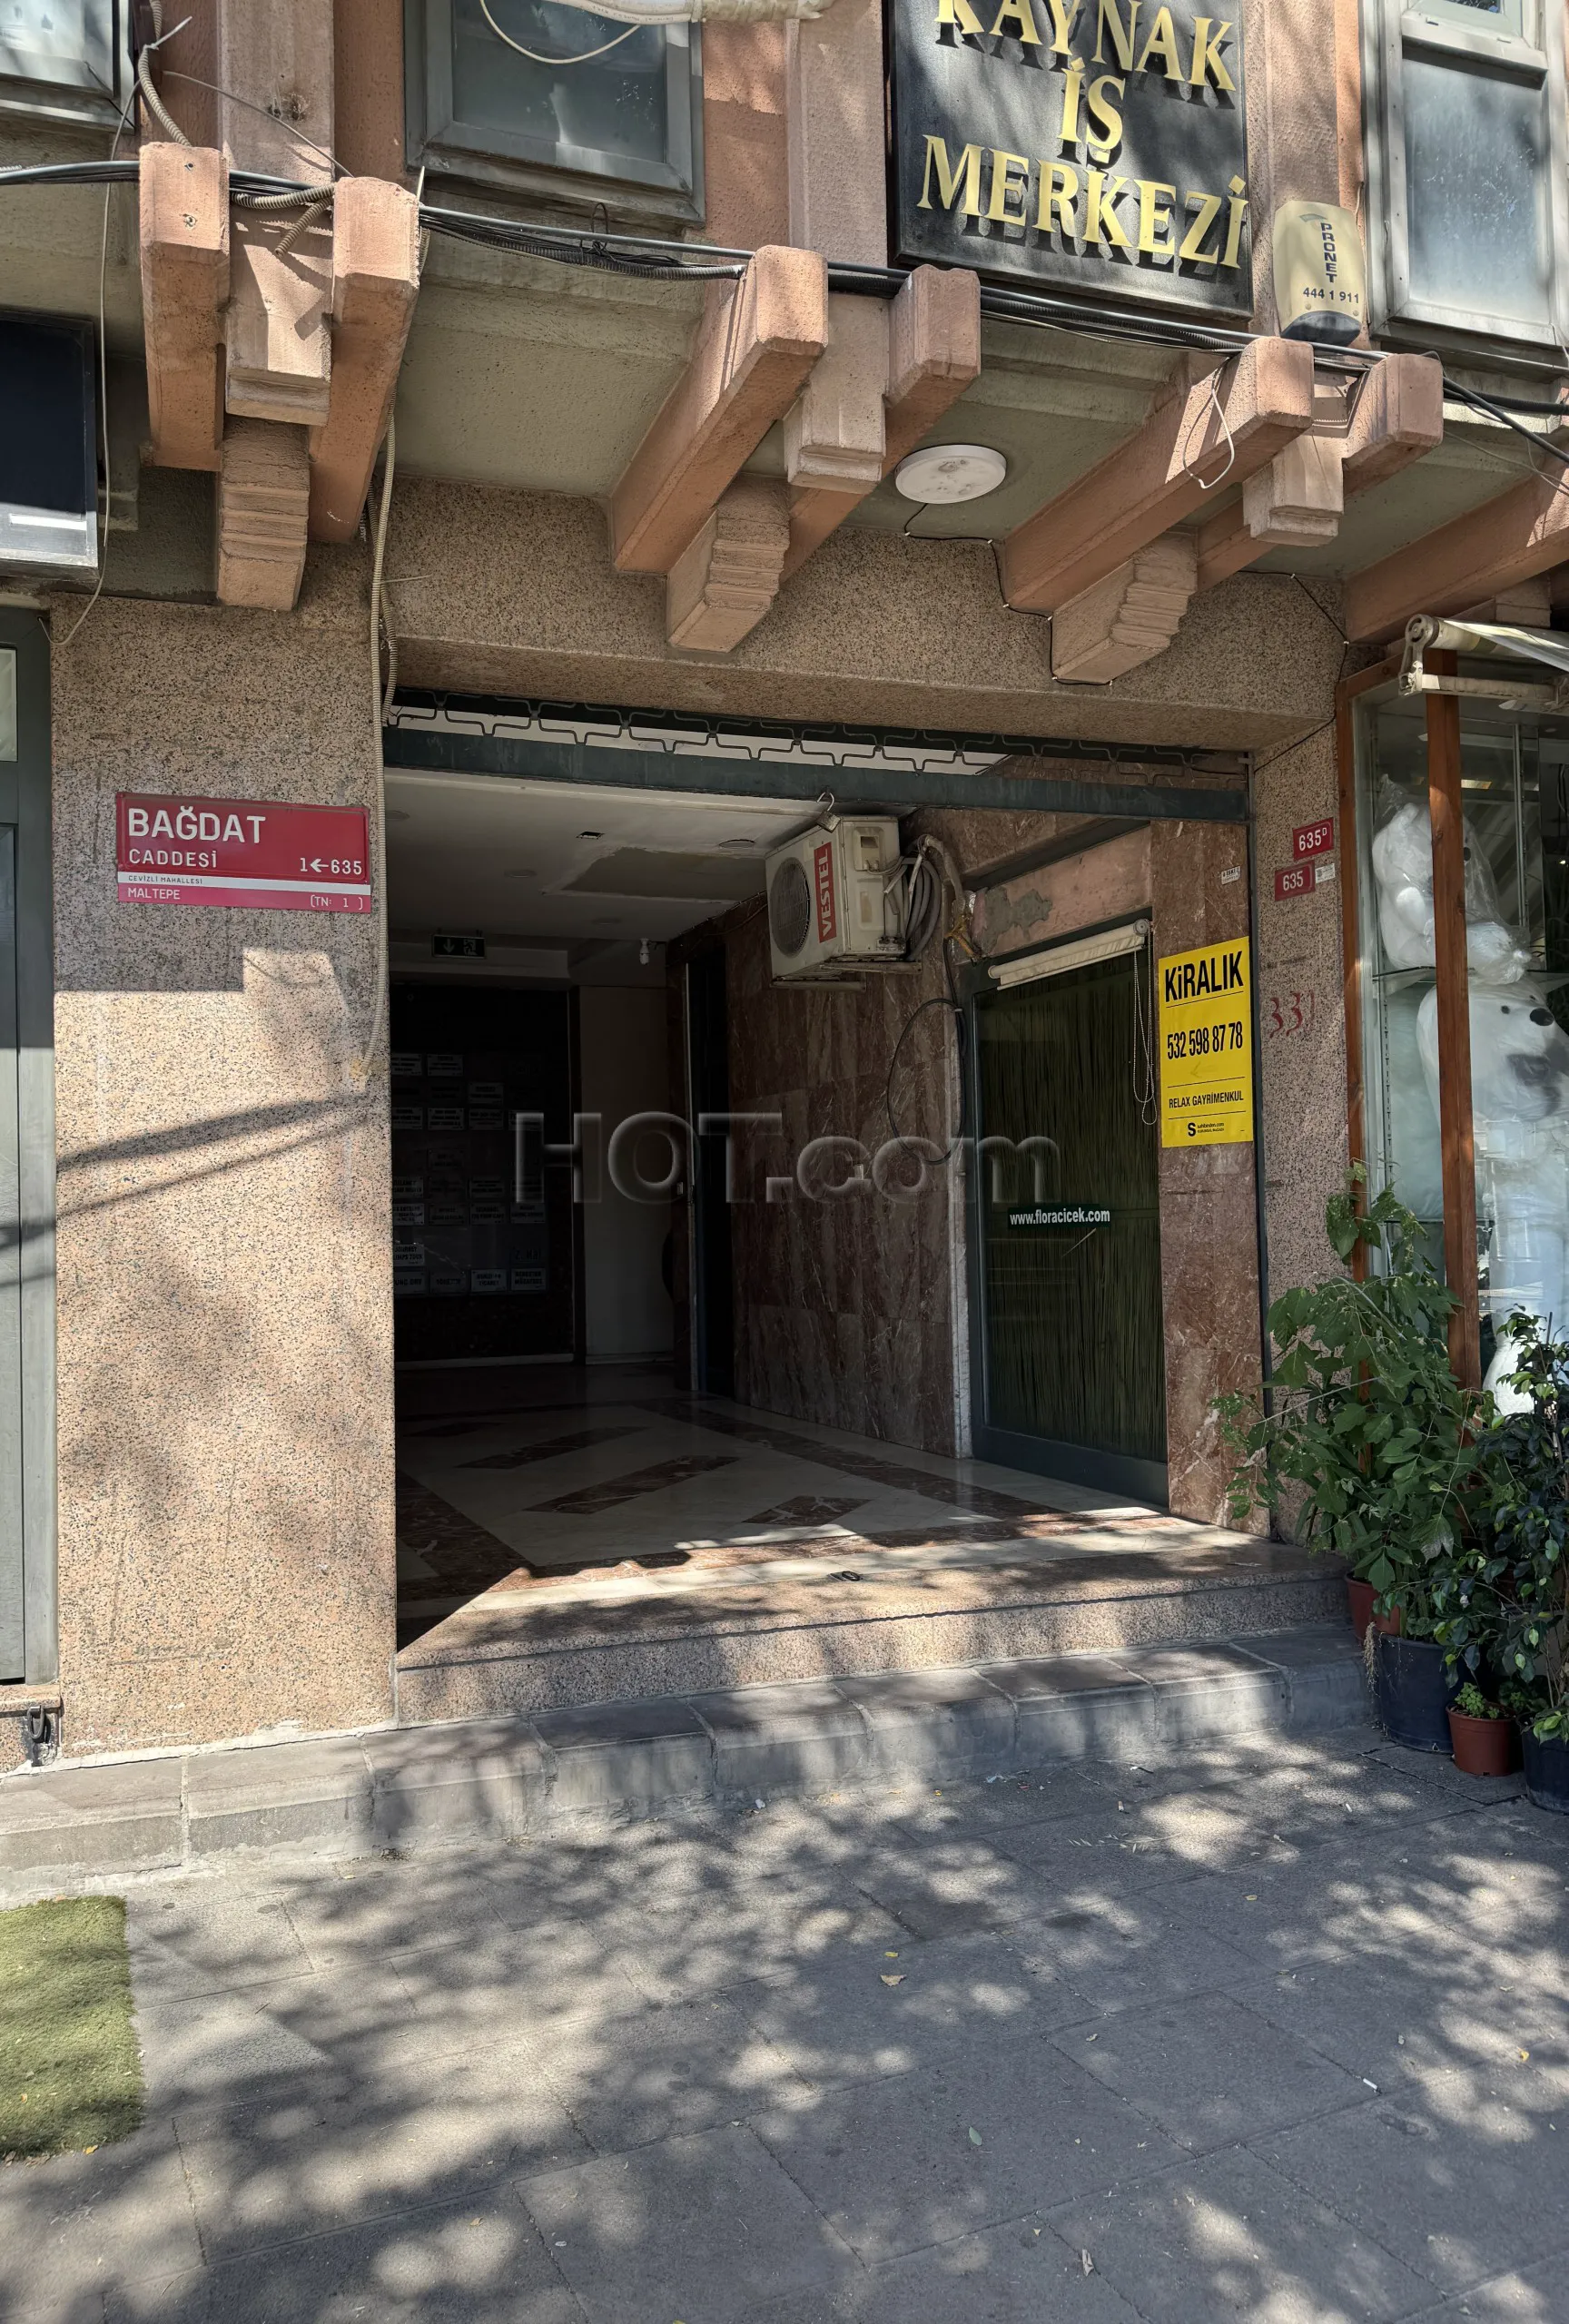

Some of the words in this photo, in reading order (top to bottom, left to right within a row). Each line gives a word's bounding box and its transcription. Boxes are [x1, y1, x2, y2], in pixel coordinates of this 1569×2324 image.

[1057, 57, 1126, 164] İŞ
[917, 134, 1248, 269] MERKEZİ
[1320, 222, 1337, 283] PRONET
[1303, 287, 1325, 299] 444
[1329, 290, 1334, 300] 1
[1339, 291, 1359, 303] 911
[128, 805, 266, 843] BAĞDAT
[129, 848, 217, 868] CADDESİ
[127, 887, 181, 900] MALTEPE
[817, 847, 834, 937] VESTEL
[1282, 872, 1304, 891] 635
[1167, 1031, 1187, 1059] 532
[1189, 1027, 1209, 1056] 598
[1212, 1024, 1226, 1052] 87
[1229, 1020, 1243, 1049] 78
[1169, 1096, 1190, 1108] RELAX
[1192, 1089, 1244, 1106] GAYRİMENKUL
[1009, 1207, 1110, 1226] www.floracicek.com
